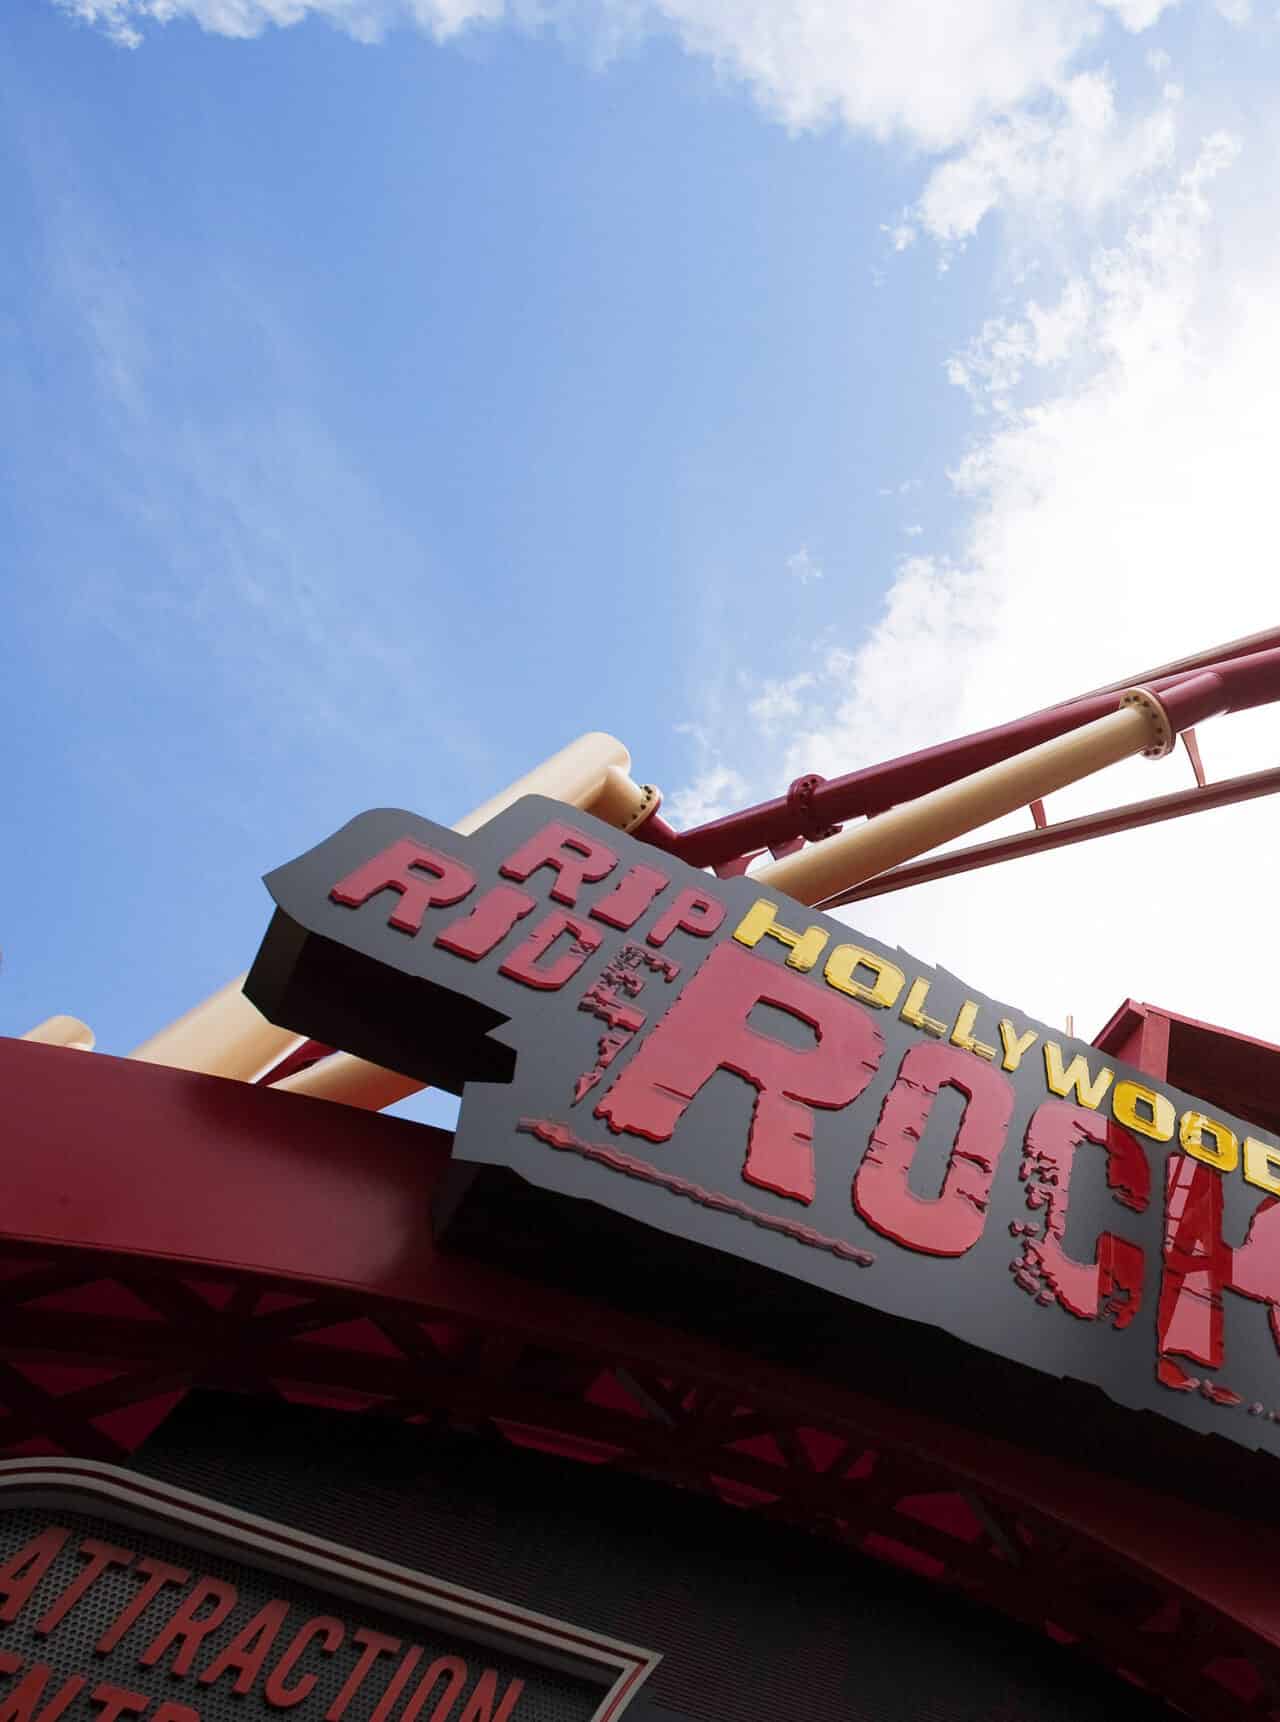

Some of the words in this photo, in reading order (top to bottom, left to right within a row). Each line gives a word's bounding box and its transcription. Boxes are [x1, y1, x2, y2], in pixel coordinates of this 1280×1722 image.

[329, 836, 682, 1032] RIDE
[499, 822, 727, 947] RIP
[0, 1526, 526, 1722] ATTRACTION
